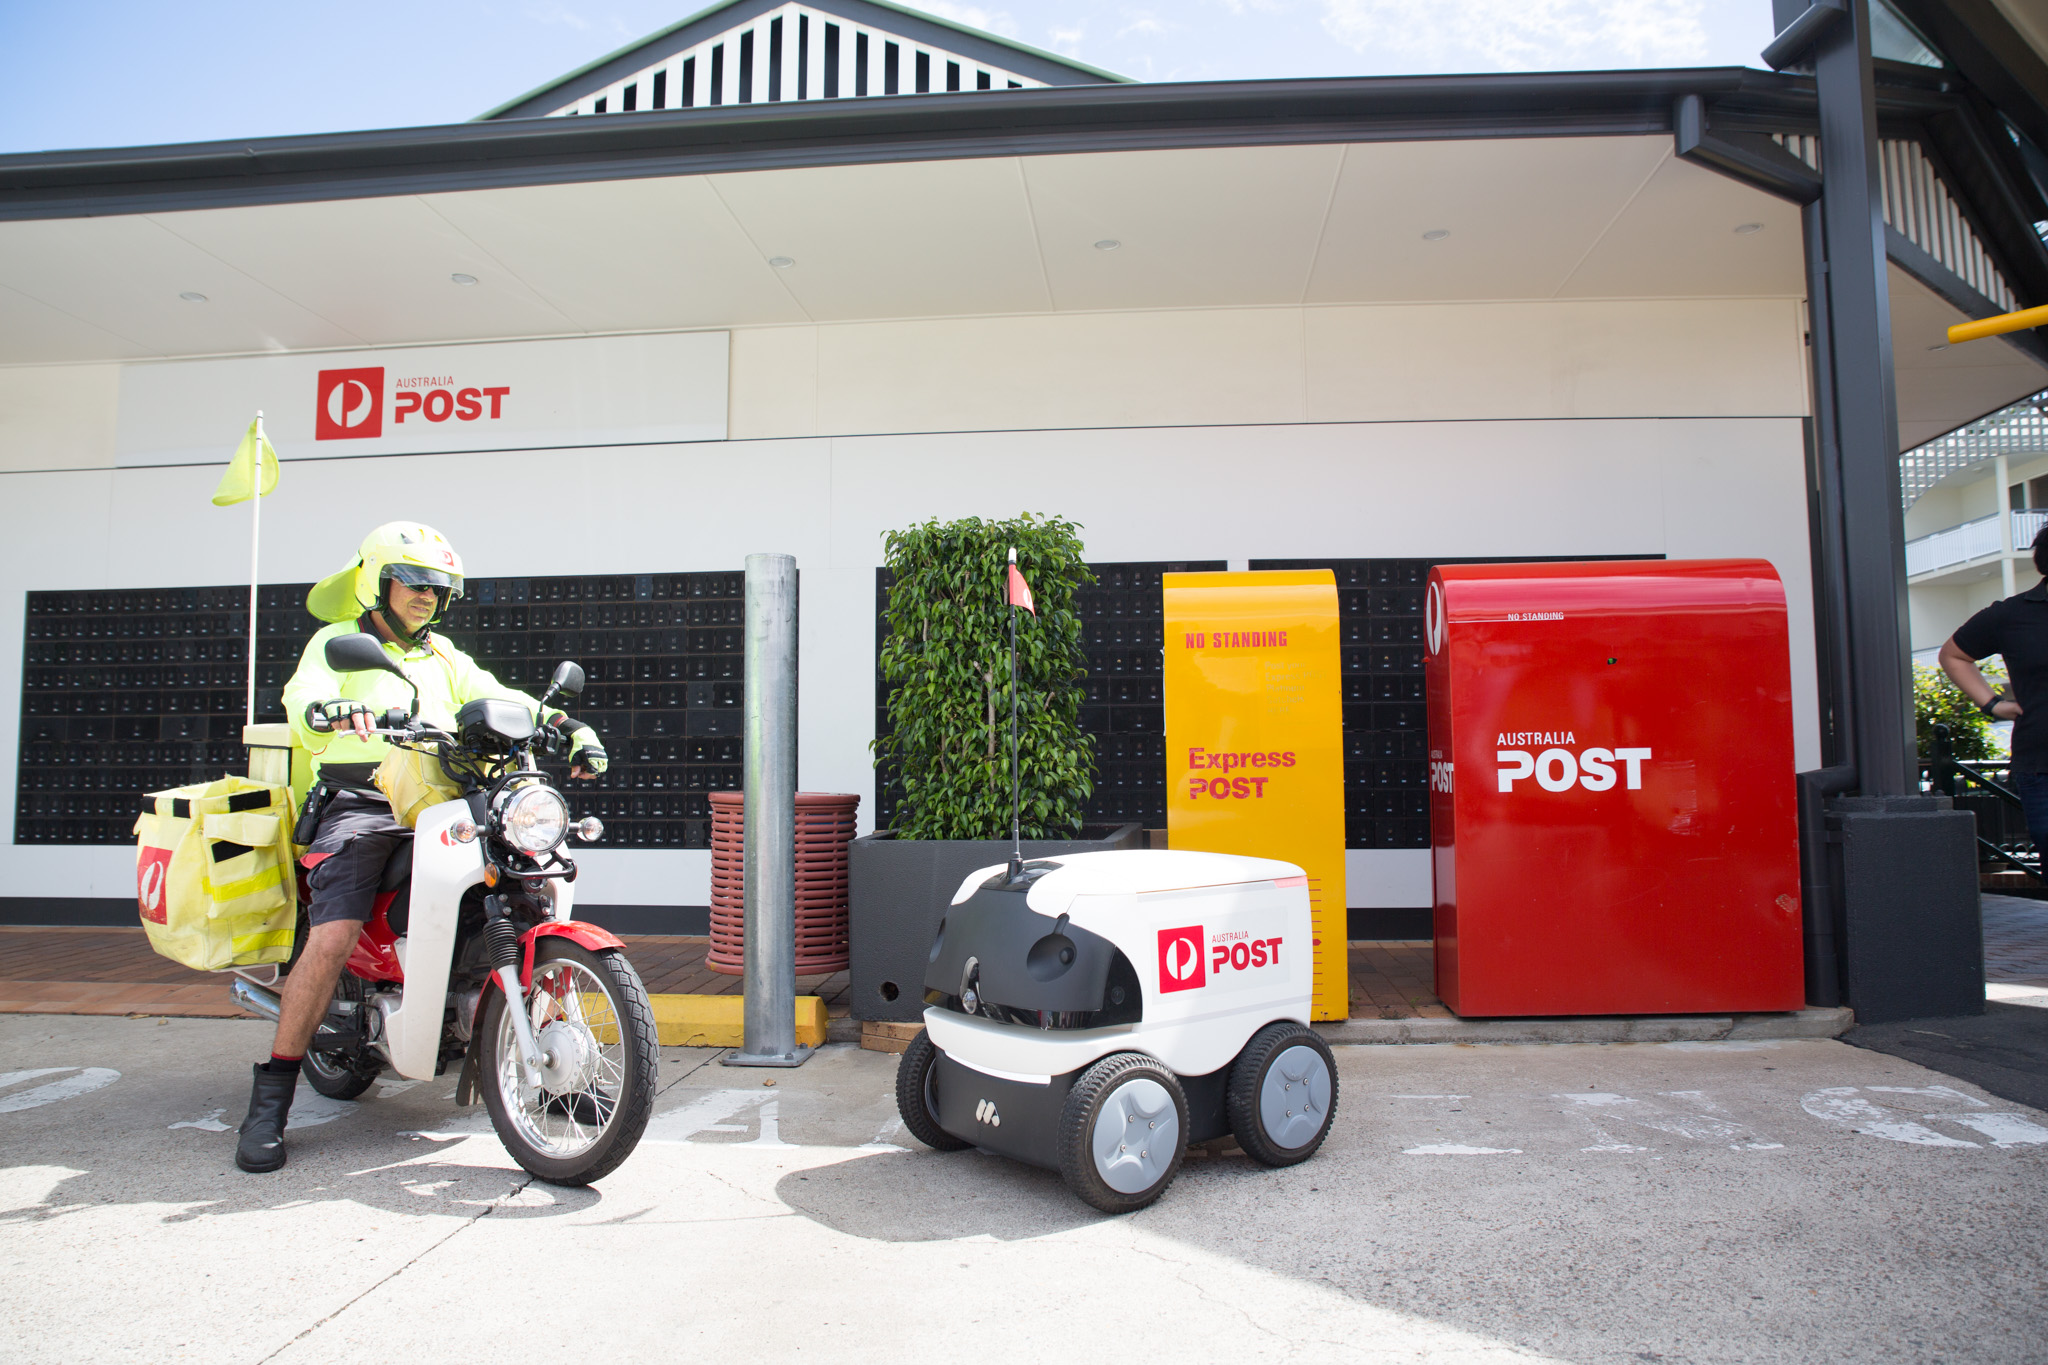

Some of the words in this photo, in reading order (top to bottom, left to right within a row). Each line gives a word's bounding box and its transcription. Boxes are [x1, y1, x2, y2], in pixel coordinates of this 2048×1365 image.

[396, 376, 454, 388] AUSTRALIA
[395, 387, 510, 423] POST
[1508, 613, 1520, 621] NO
[1522, 611, 1564, 620] STANDING
[1185, 633, 1205, 649] NO
[1213, 631, 1288, 648] STANDING
[1497, 731, 1576, 746] AUSTRALIA
[1189, 747, 1296, 773] Express
[1497, 747, 1652, 793] POST
[1189, 777, 1269, 800] POST
[1431, 761, 1454, 794] POST
[1212, 931, 1249, 943] AUSTRALIA
[1212, 938, 1282, 973] POST
